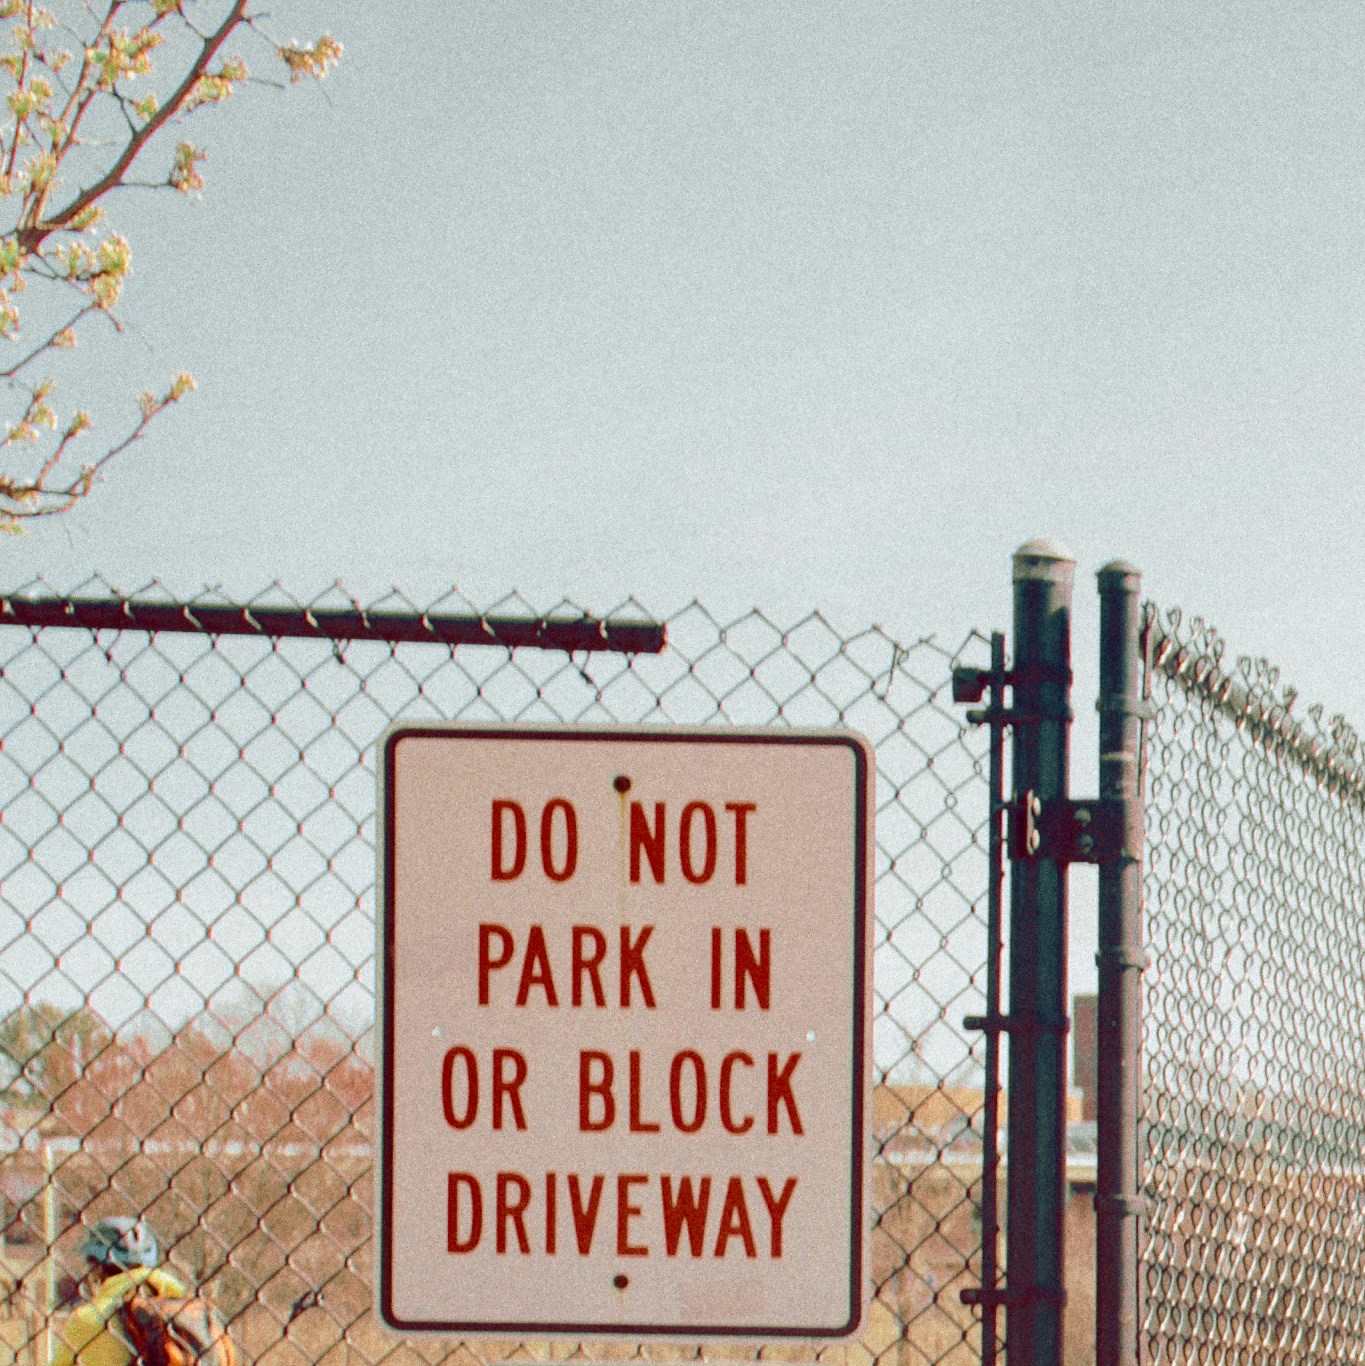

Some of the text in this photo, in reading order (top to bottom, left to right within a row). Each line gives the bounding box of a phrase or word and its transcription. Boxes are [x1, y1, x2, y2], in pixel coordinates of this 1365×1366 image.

[490, 797, 757, 886] DO NOT
[477, 923, 771, 1010] PARK IN
[441, 1045, 804, 1136] OR BLOCK
[446, 1172, 798, 1258] DRIVEWAY
